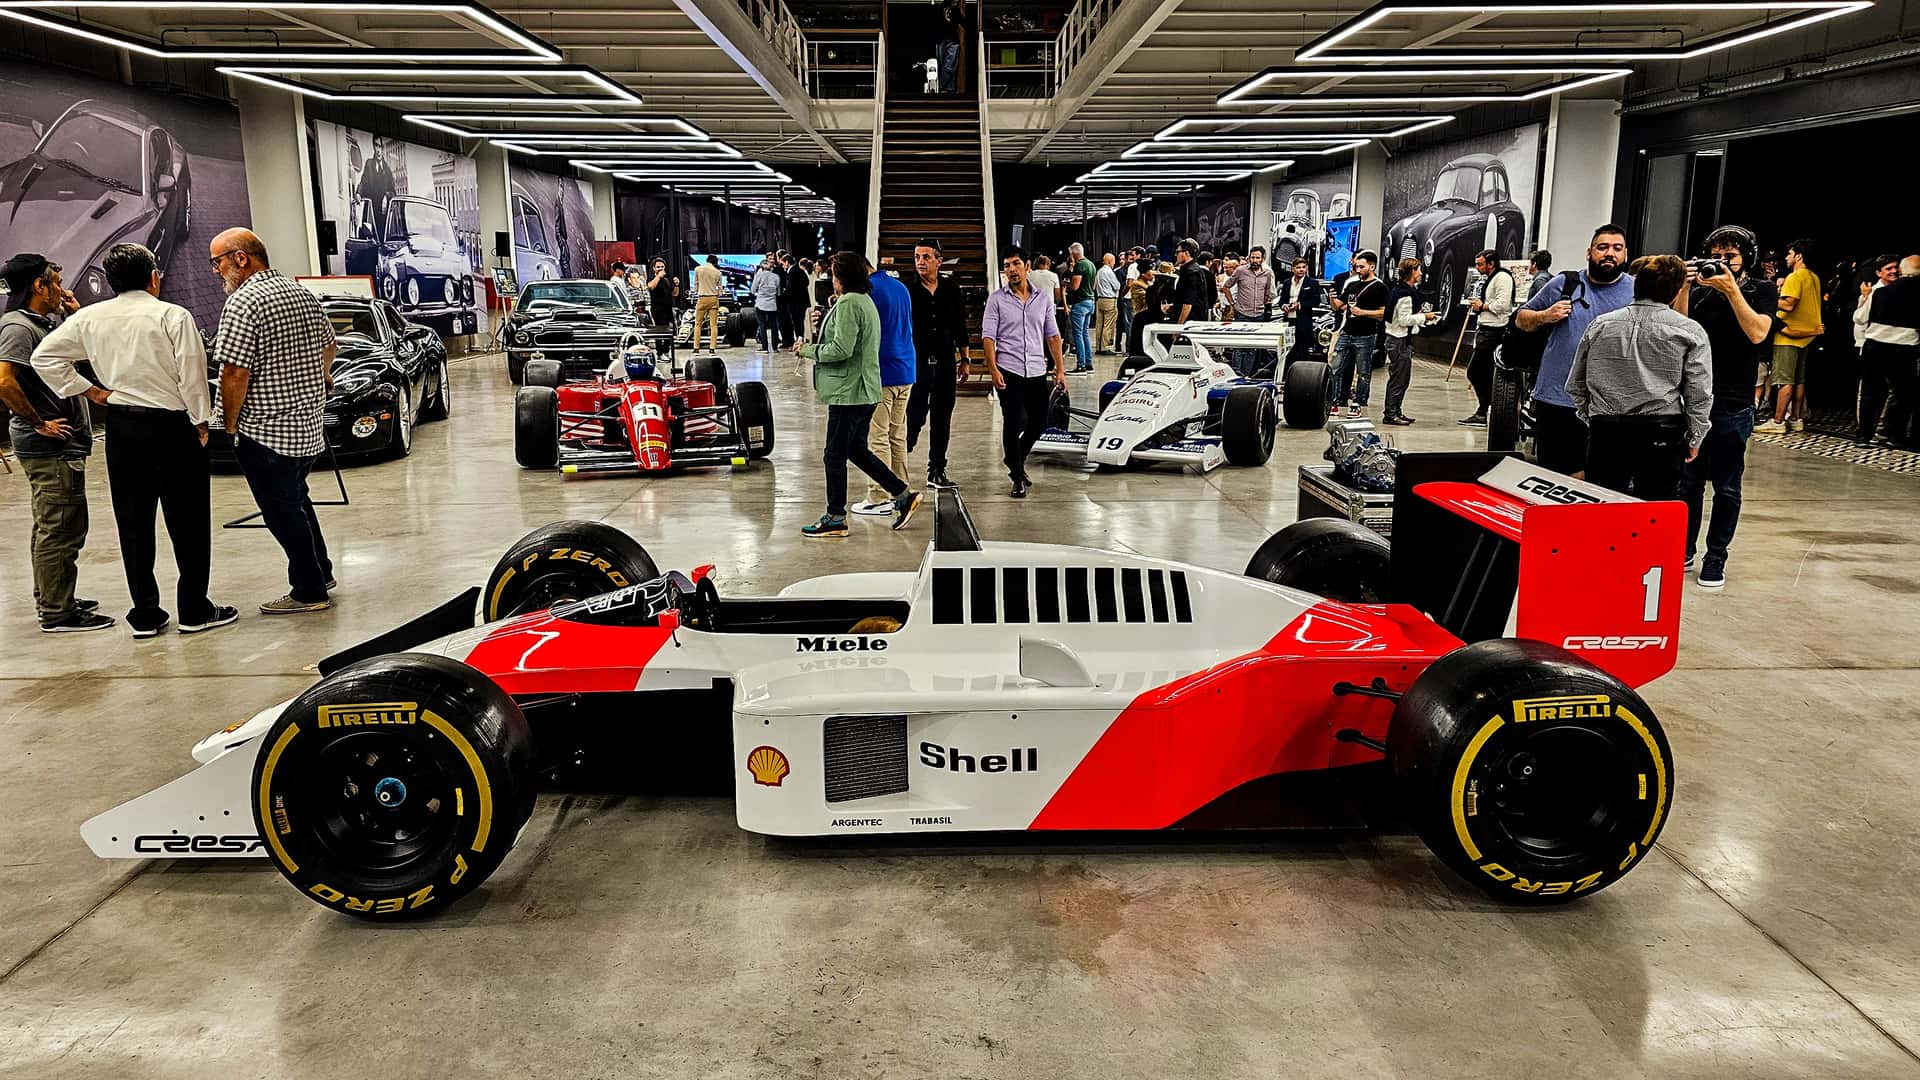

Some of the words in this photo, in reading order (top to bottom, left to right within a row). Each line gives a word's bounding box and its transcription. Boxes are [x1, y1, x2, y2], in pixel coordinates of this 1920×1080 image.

[638, 405, 658, 417] 11
[1104, 413, 1147, 425] Candy
[1096, 436, 1124, 451] 19
[523, 553, 539, 572] P
[549, 548, 630, 588] ZERO
[1642, 566, 1662, 622] 1
[796, 637, 888, 652] Miele
[317, 701, 418, 729] PIRELLI
[1512, 694, 1611, 723] PIRELLI
[919, 741, 1038, 773] Shell
[831, 818, 883, 826] ARGENTEC
[910, 816, 952, 825] TRABASIL
[450, 854, 469, 885] P
[1618, 842, 1638, 871] P
[1480, 862, 1604, 896] ZERO
[308, 883, 436, 914] ZERO
